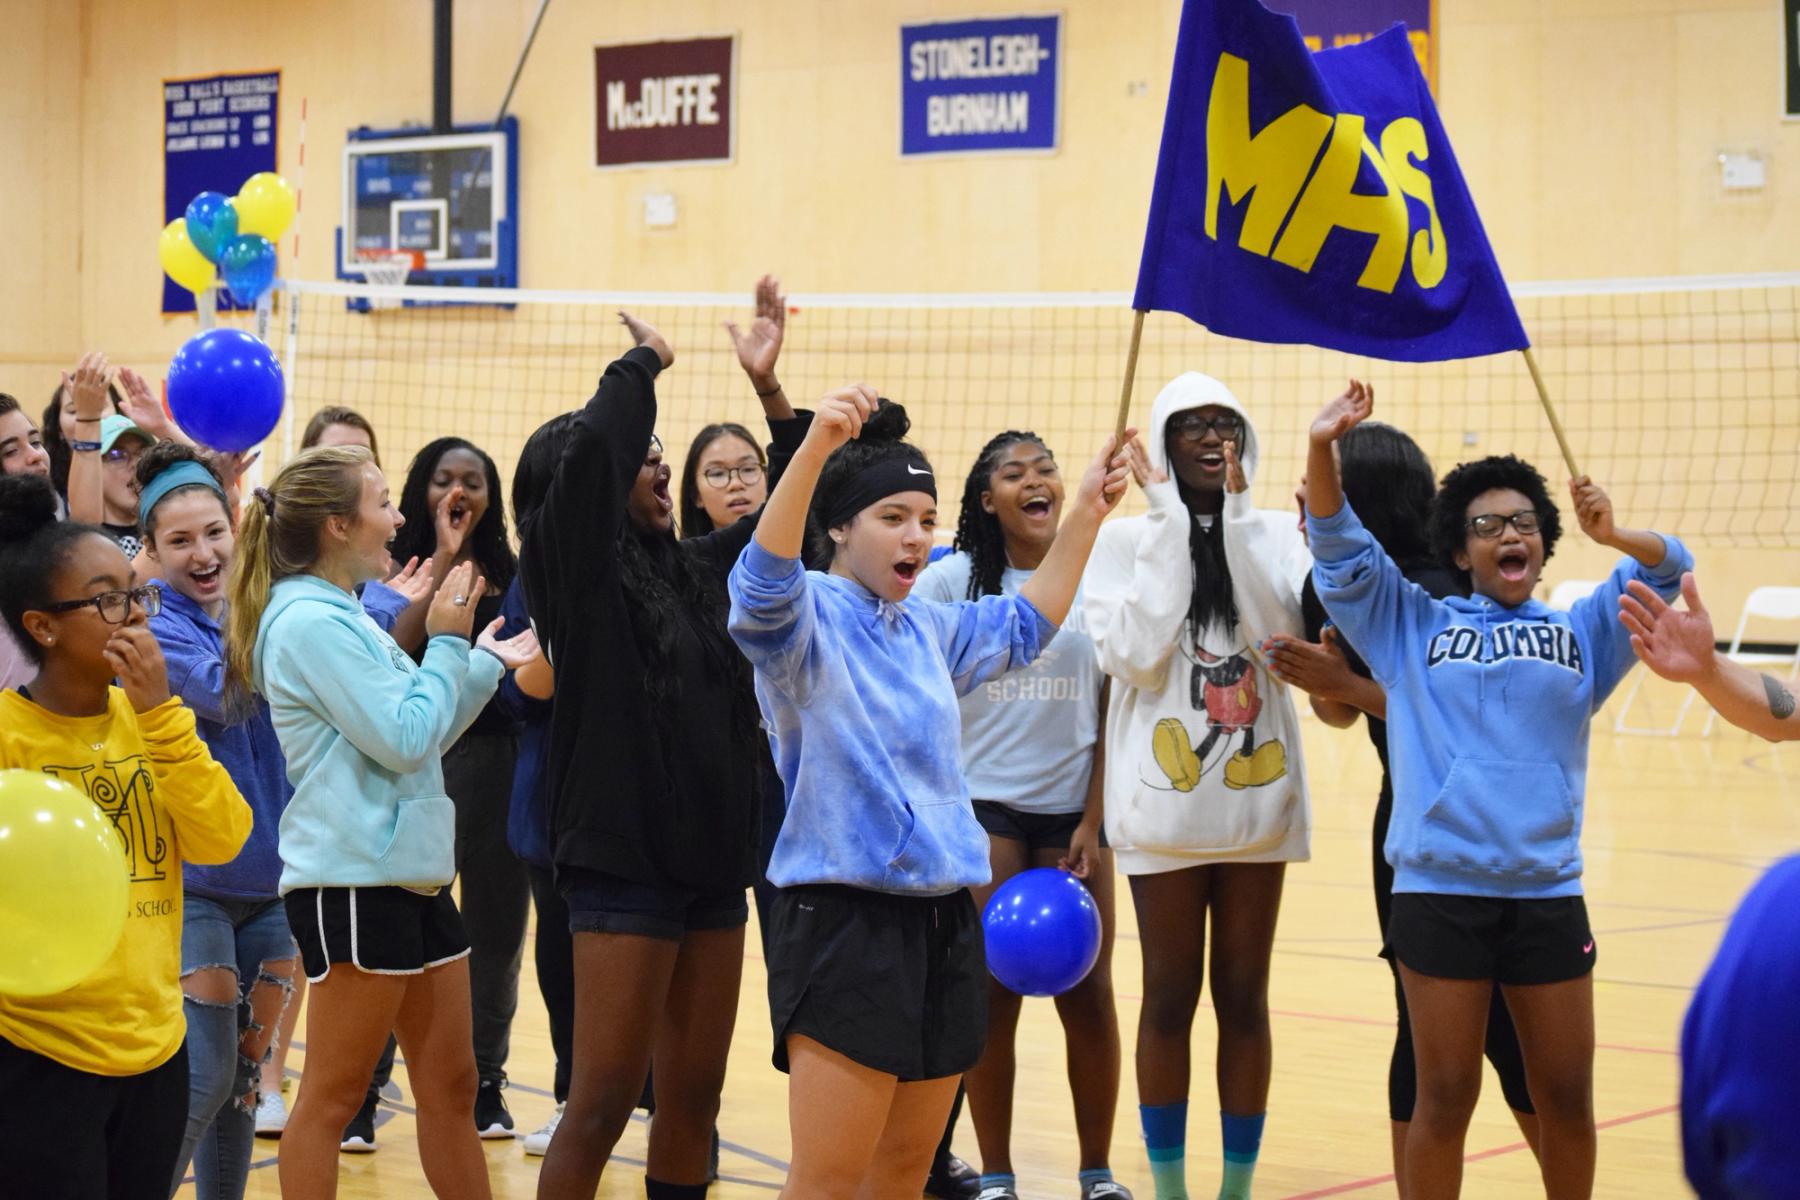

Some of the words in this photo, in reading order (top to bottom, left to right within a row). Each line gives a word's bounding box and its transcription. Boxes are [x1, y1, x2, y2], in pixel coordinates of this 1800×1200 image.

[910, 34, 1049, 81] STONELEIGH-
[927, 91, 1028, 137] BURNHAM
[1204, 51, 1447, 294] MAS
[1427, 623, 1584, 676] COLUMBIA
[986, 676, 1081, 702] SCHOOL
